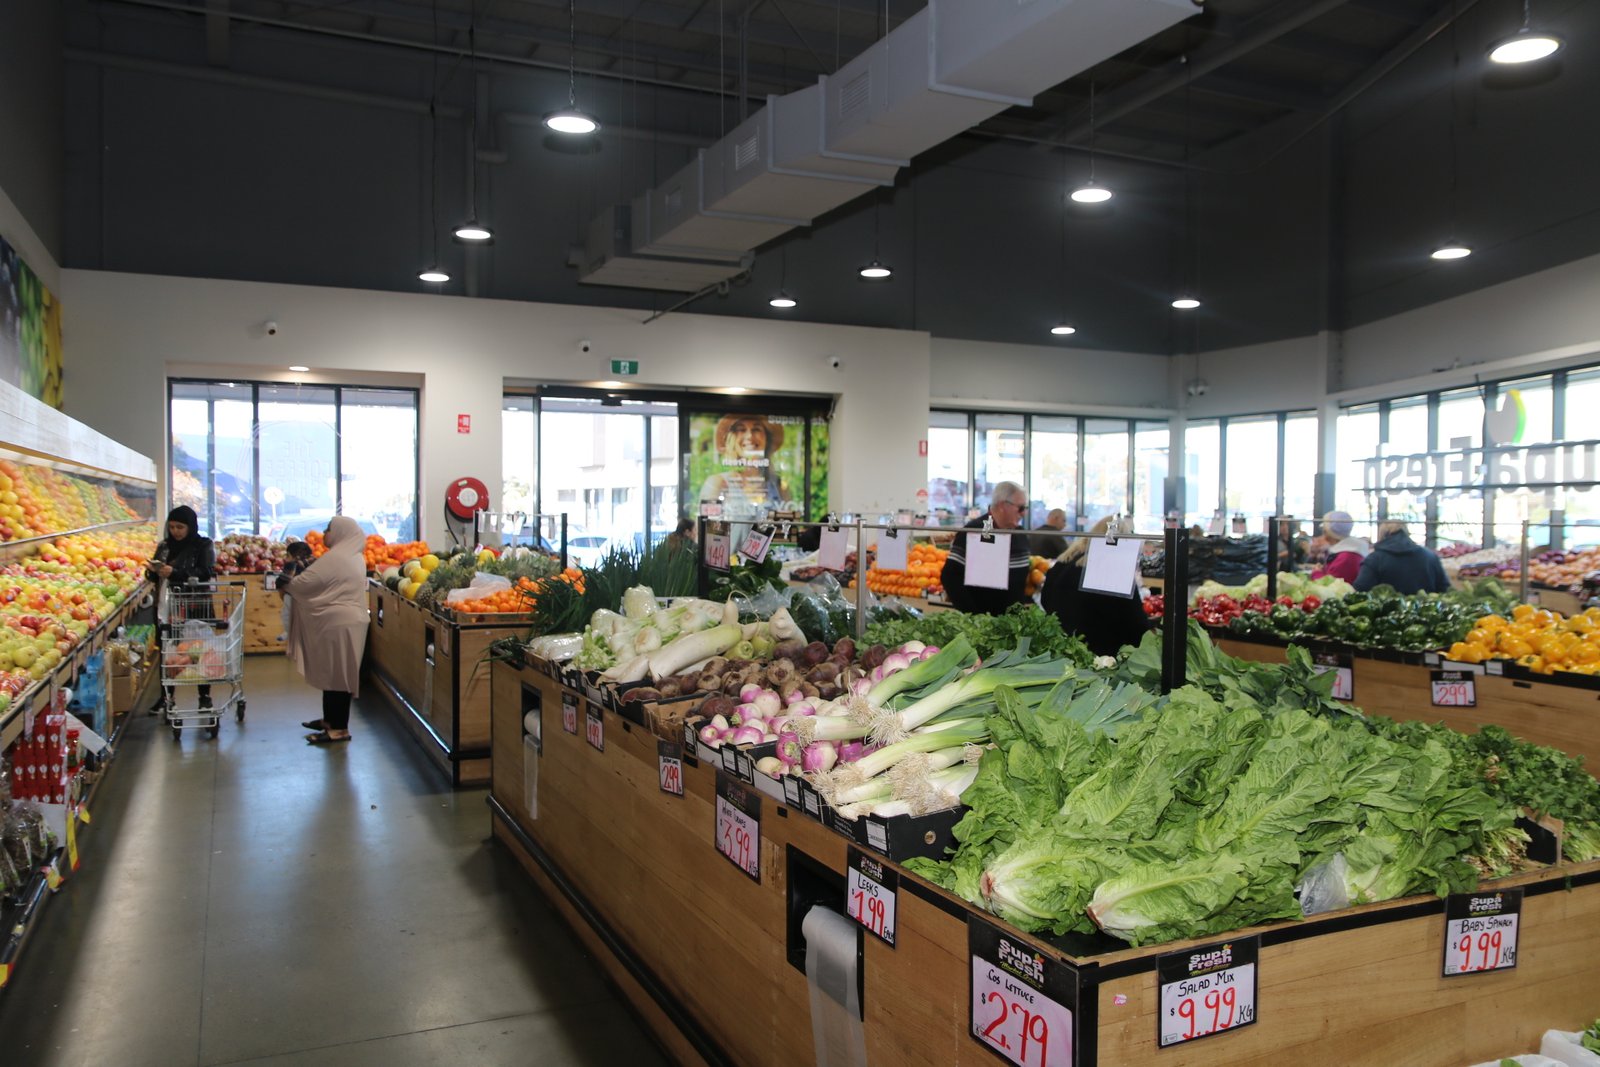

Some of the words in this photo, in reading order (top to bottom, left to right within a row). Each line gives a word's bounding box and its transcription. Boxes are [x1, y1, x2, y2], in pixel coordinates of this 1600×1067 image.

[857, 873, 879, 898] LEEKS
[1469, 902, 1502, 912] Fresh
[1470, 896, 1502, 906] Supa
[1460, 919, 1485, 934] BABY
[1000, 939, 1045, 973] Supa
[1188, 954, 1233, 972] Fresh
[1190, 948, 1232, 963] Supa
[998, 947, 1045, 984] Fresh
[1005, 978, 1035, 1004] LETTUCE
[1178, 979, 1211, 997] SALAD
